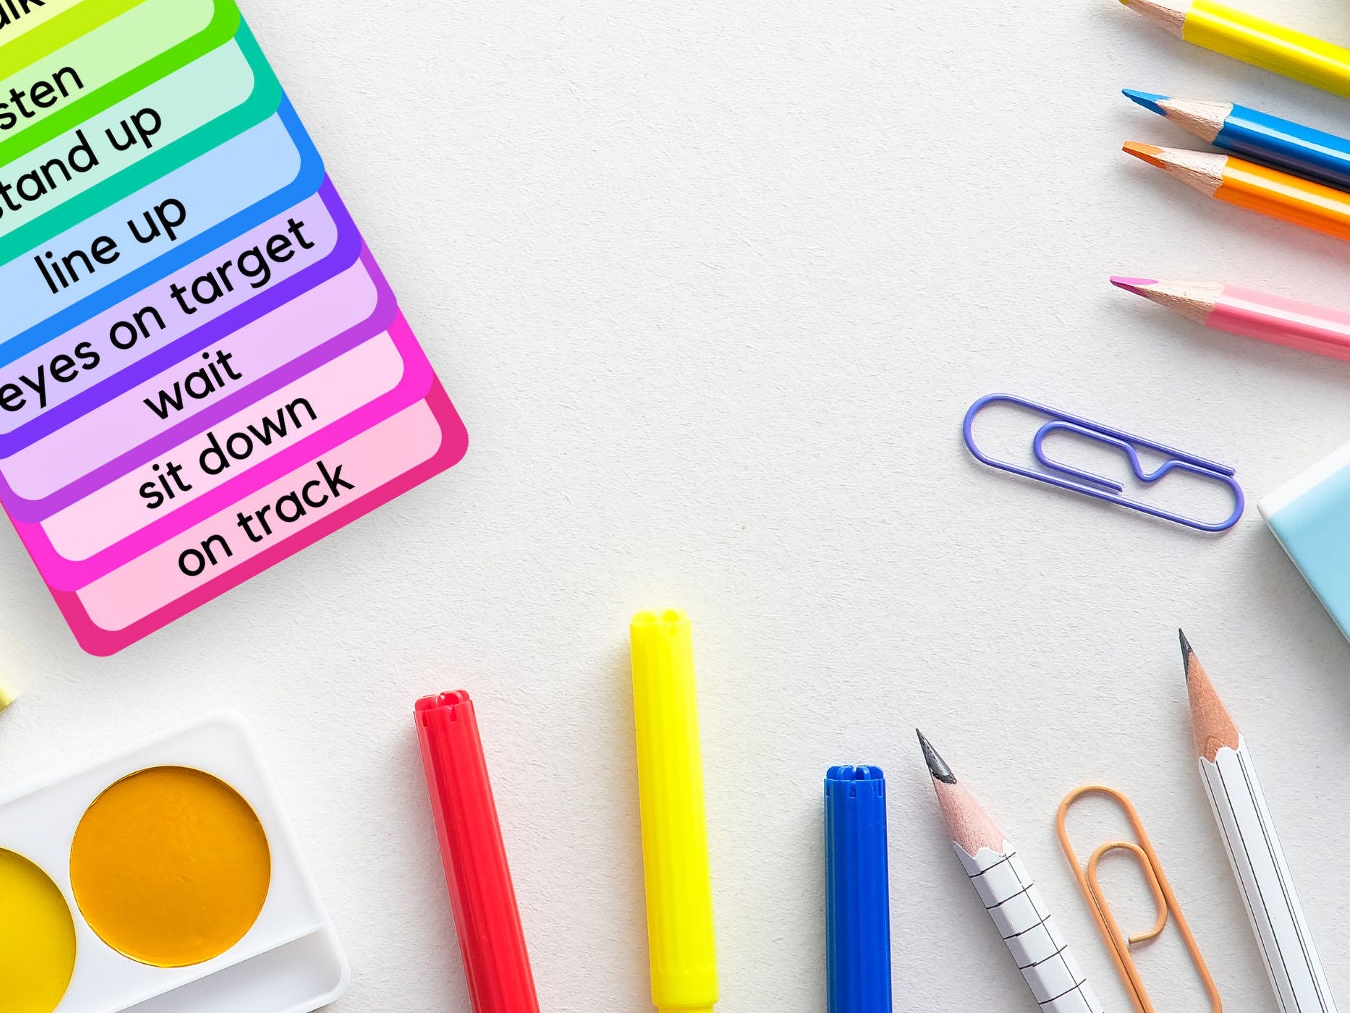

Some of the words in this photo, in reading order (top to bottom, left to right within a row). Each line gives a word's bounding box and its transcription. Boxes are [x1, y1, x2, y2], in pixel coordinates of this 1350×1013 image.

[104, 107, 162, 151] up
[34, 235, 121, 294] line
[127, 198, 187, 244] up
[109, 306, 167, 350] on
[169, 218, 315, 315] target
[143, 350, 243, 420] wait
[139, 461, 193, 509] sit
[199, 397, 318, 475] down
[178, 534, 233, 577] on
[237, 460, 355, 543] track
